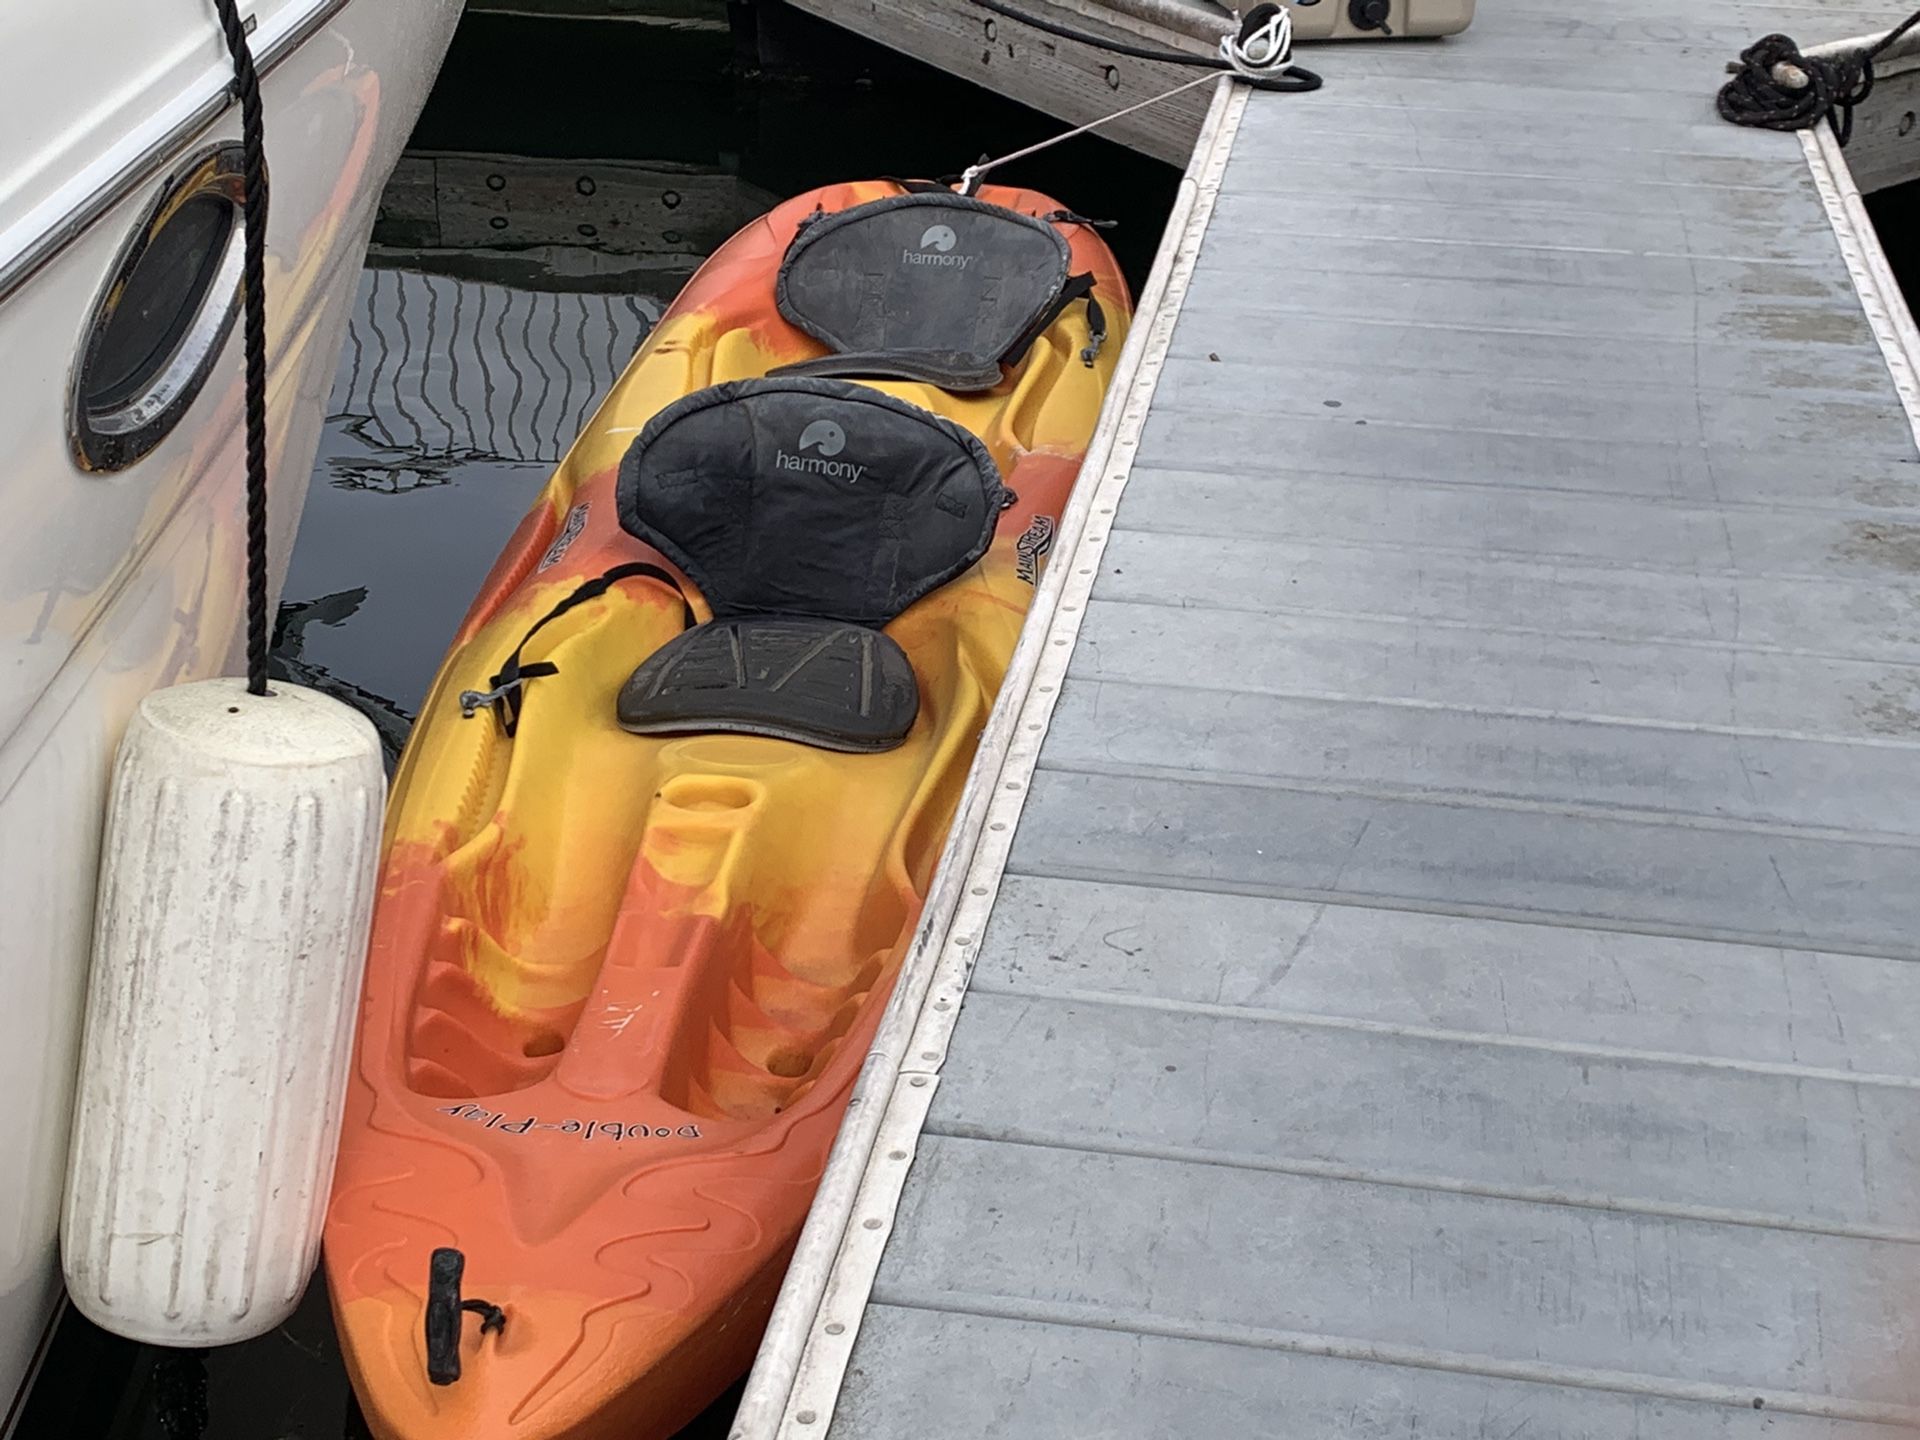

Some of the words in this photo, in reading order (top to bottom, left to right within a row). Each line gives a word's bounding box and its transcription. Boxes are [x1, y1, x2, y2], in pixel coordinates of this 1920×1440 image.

[903, 249, 969, 270] harmony
[775, 449, 863, 484] harmony
[1016, 515, 1051, 585] MAINSTREAM
